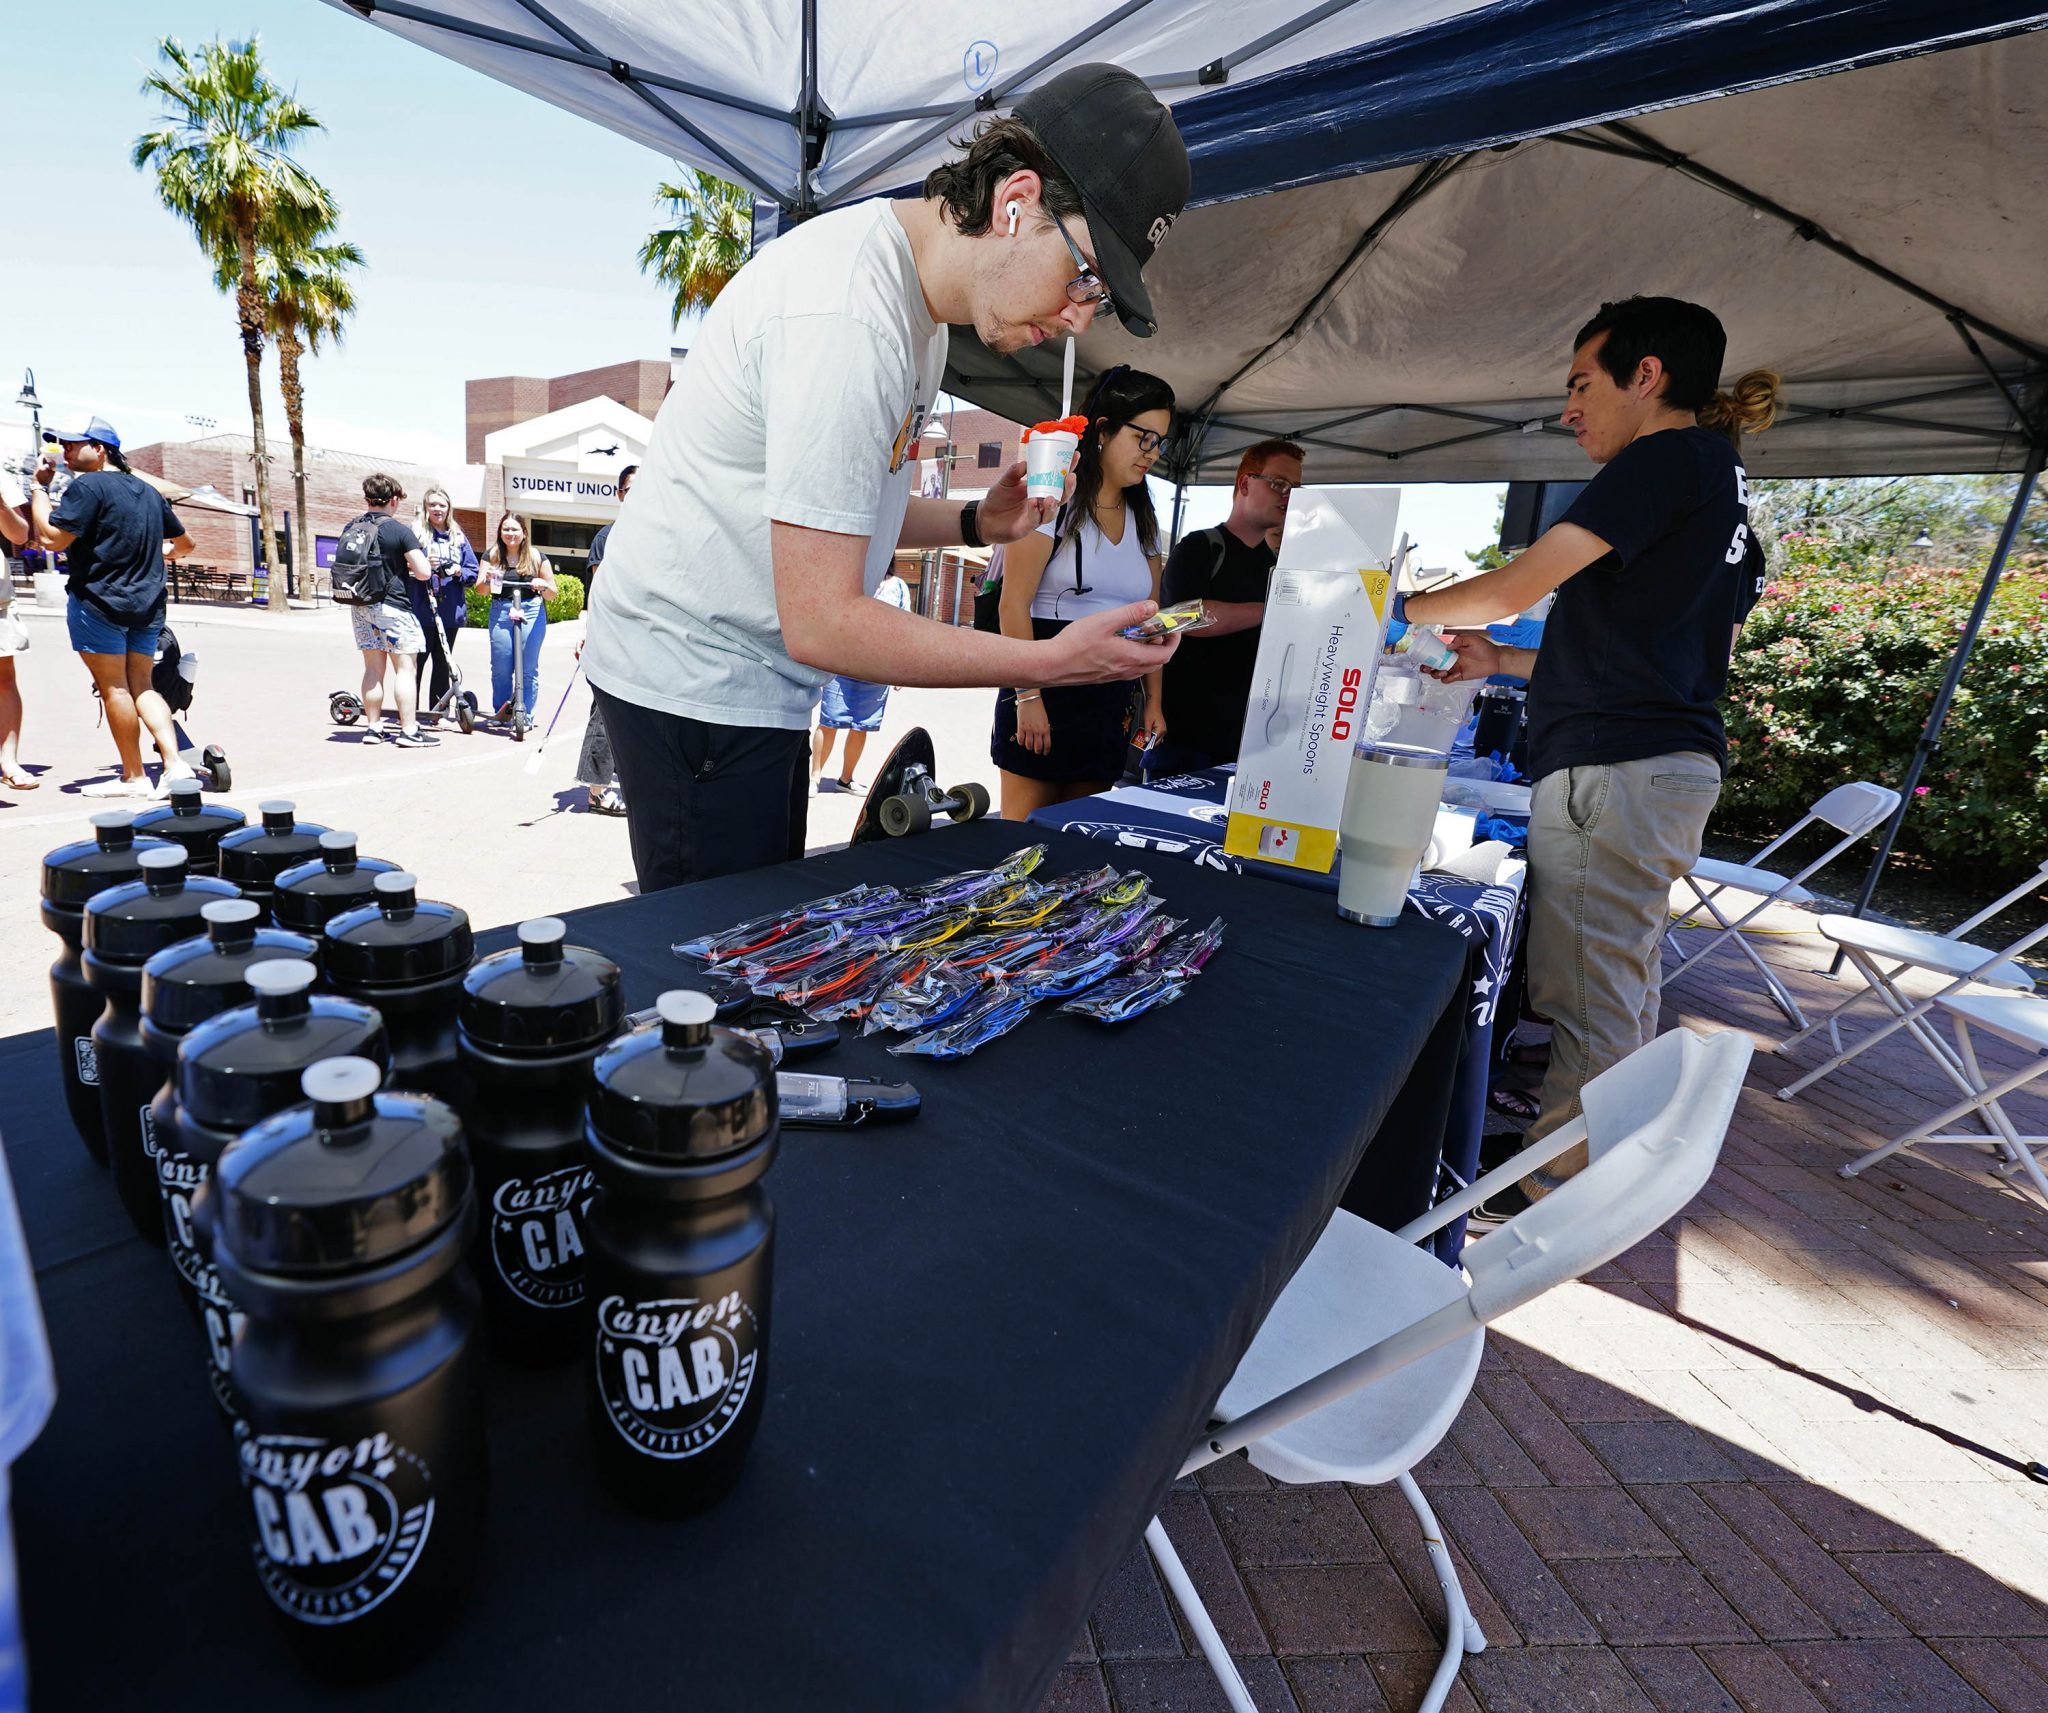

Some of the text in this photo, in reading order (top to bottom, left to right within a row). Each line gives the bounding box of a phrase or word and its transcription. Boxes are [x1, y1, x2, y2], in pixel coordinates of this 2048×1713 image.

[512, 477, 572, 493] STUDENT
[1263, 678, 1272, 698] Actual
[1303, 625, 1345, 775] Heavyweight Spoons
[1331, 668, 1362, 741] SOLO
[1258, 780, 1271, 810] SOLO
[493, 1164, 601, 1217] Canyo
[598, 1291, 744, 1347] Canyon
